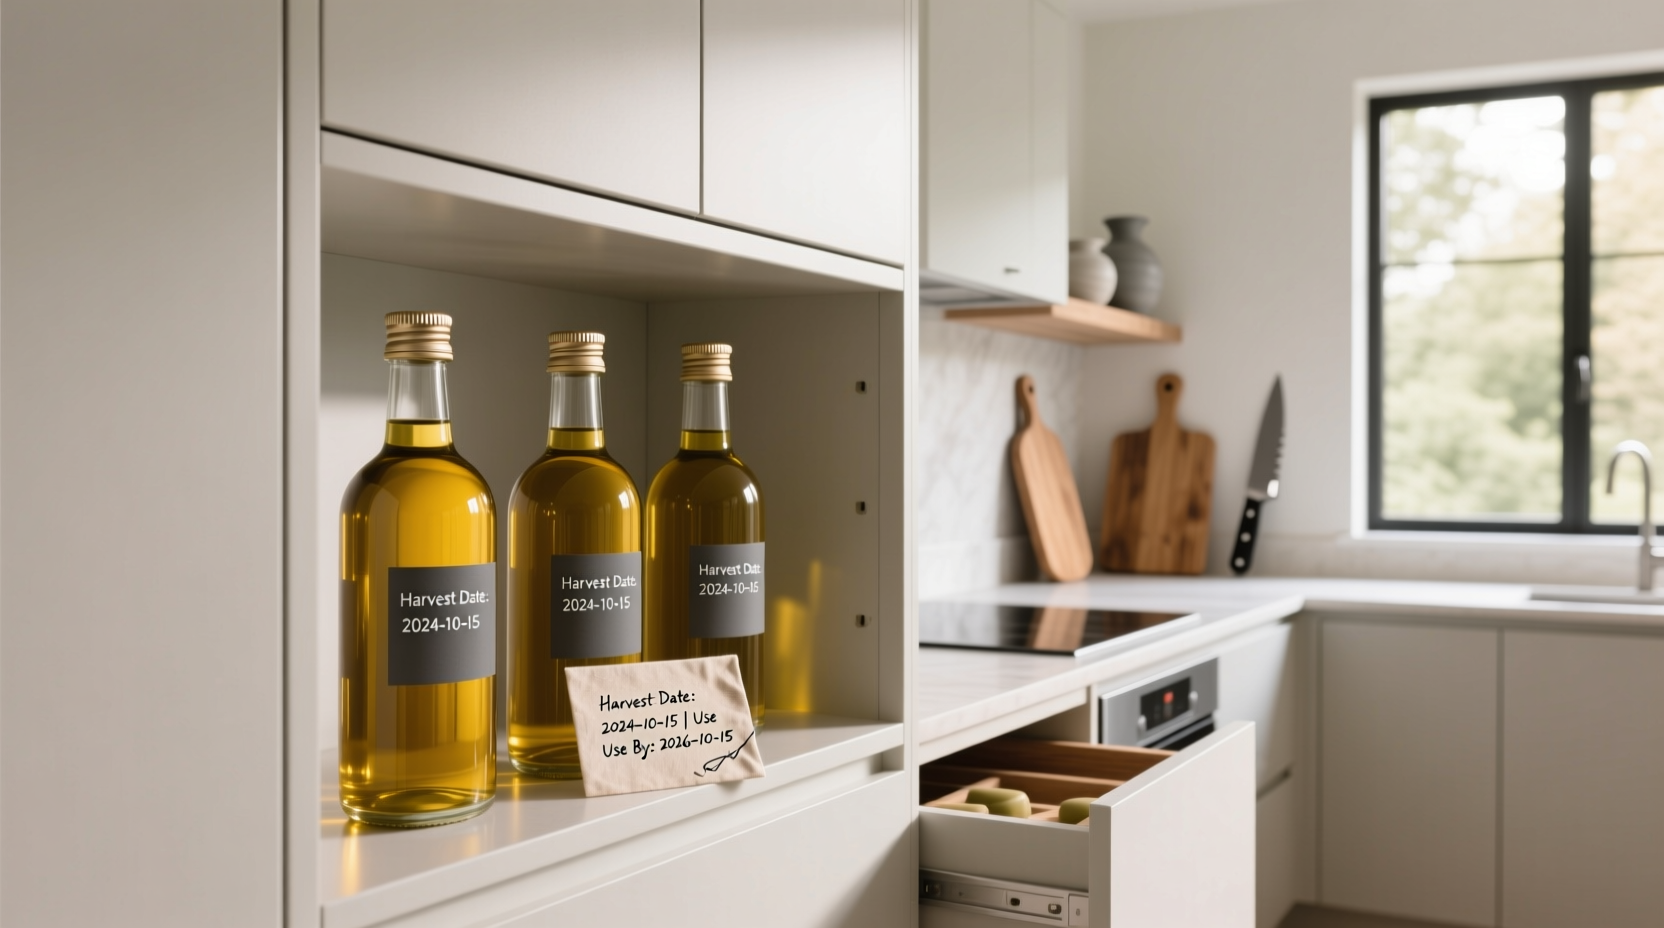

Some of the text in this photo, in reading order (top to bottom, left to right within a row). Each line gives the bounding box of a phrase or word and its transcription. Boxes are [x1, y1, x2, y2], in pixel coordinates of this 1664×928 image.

[561, 574, 611, 590] Harvest
[698, 581, 759, 596] 2024-10-15
[400, 589, 489, 607] Harvest Date:
[562, 596, 631, 612] 2024-10-15
[402, 614, 480, 633] 2024-10-15
[599, 690, 696, 712] Harvest Date:
[601, 713, 678, 735] 2024-10-15
[693, 710, 717, 724] Use
[602, 729, 734, 760] Use By: 2026-10-15
